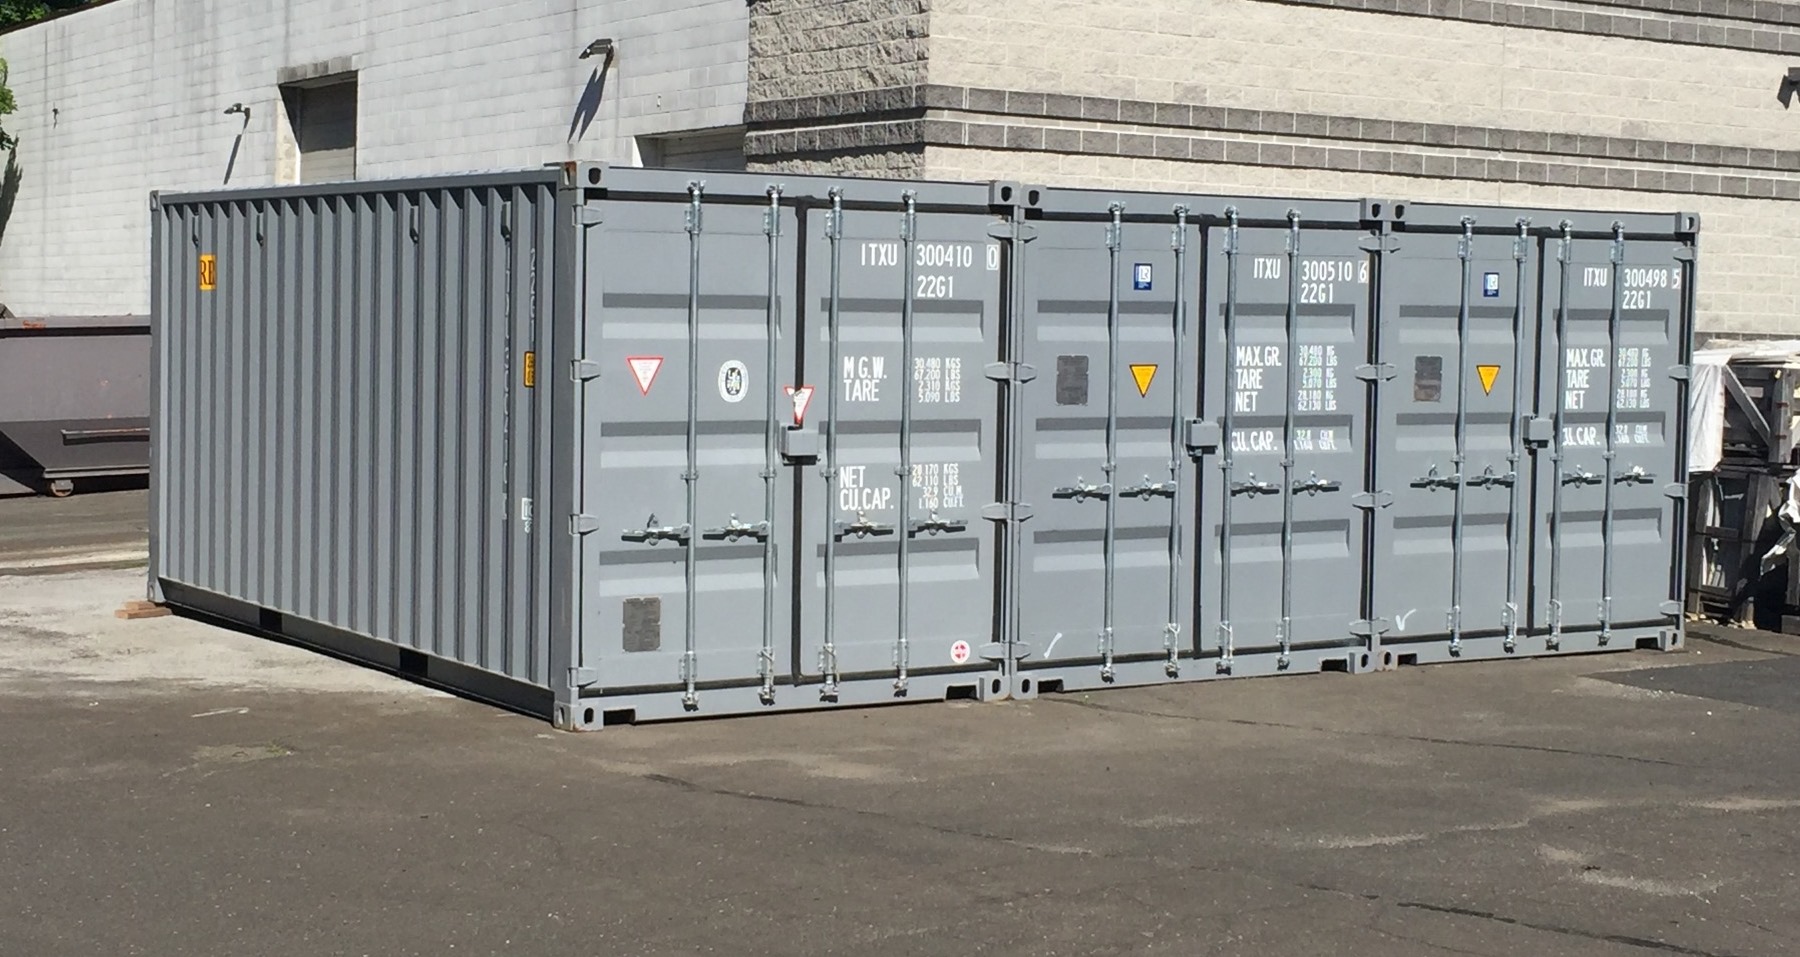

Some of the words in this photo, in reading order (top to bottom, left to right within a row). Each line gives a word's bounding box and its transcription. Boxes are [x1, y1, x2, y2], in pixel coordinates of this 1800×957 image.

[861, 243, 898, 266] ITXU
[916, 244, 973, 267] 300410
[988, 246, 998, 269] 0
[1253, 258, 1281, 279] ITXU
[1301, 260, 1352, 281] 300510
[1359, 261, 1368, 283] 6
[1583, 267, 1607, 286] ITXU
[1623, 268, 1667, 288] 300498
[1672, 268, 1681, 289] 5
[917, 275, 953, 298] 22G1
[1300, 283, 1333, 303] 22G1
[1622, 290, 1651, 309] 22G1
[1236, 369, 1263, 389] TARE
[1566, 369, 1590, 388] TARE
[843, 379, 880, 401] TARE
[1565, 390, 1585, 409] NET
[1235, 391, 1258, 412] NET
[840, 466, 866, 488] NET
